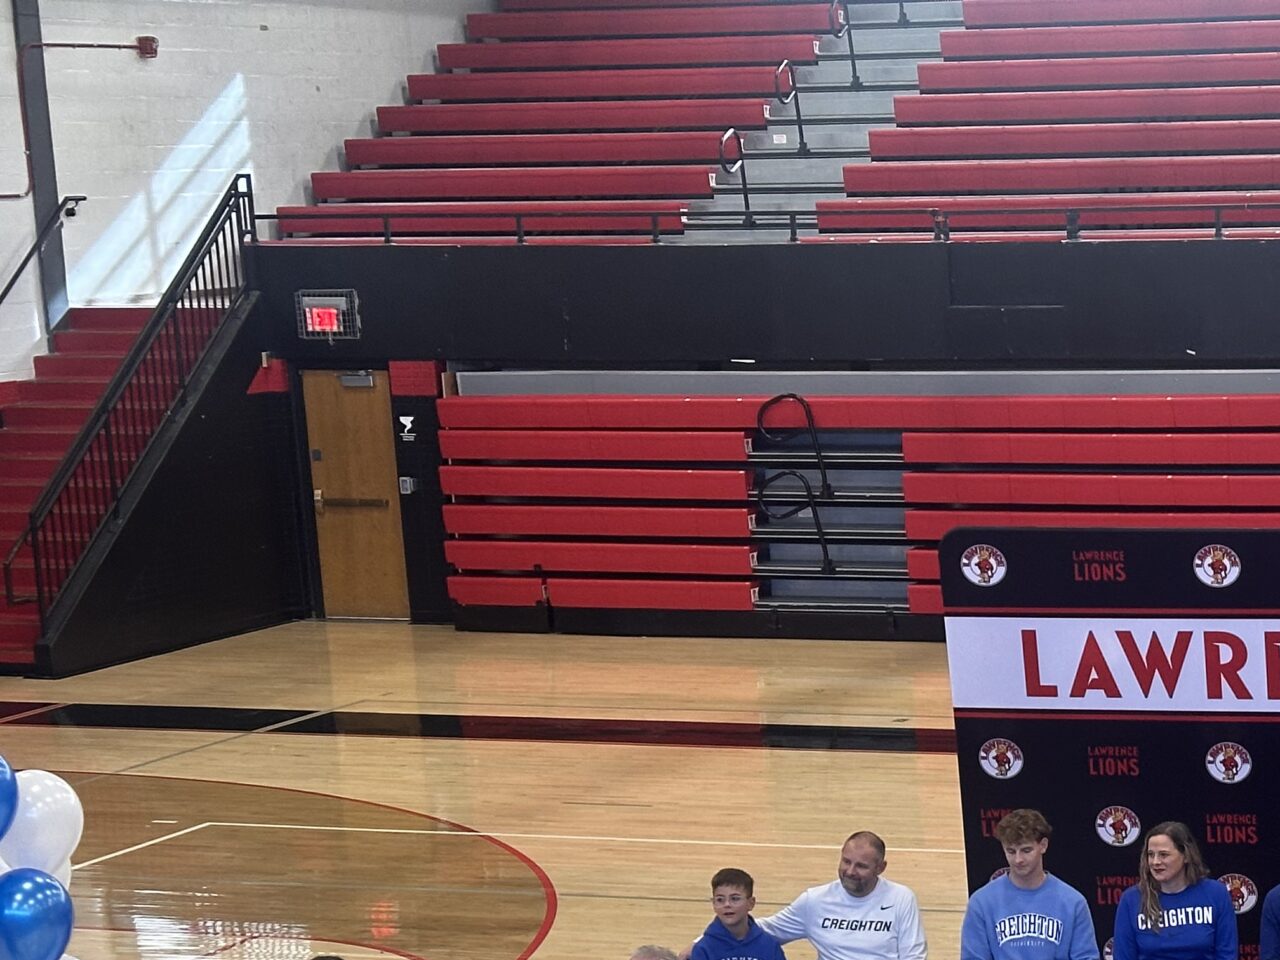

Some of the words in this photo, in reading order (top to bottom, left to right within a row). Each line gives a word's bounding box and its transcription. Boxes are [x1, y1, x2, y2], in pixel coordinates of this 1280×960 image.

[1073, 550, 1125, 561] LAWRENCE
[1074, 562, 1126, 581] LIONS
[1088, 746, 1139, 757] LAWRENCE
[1089, 758, 1140, 776] LIONS
[1206, 814, 1258, 825] LAWRENCE
[1207, 826, 1259, 844] LIONS
[821, 917, 892, 932] CREIGHTON
